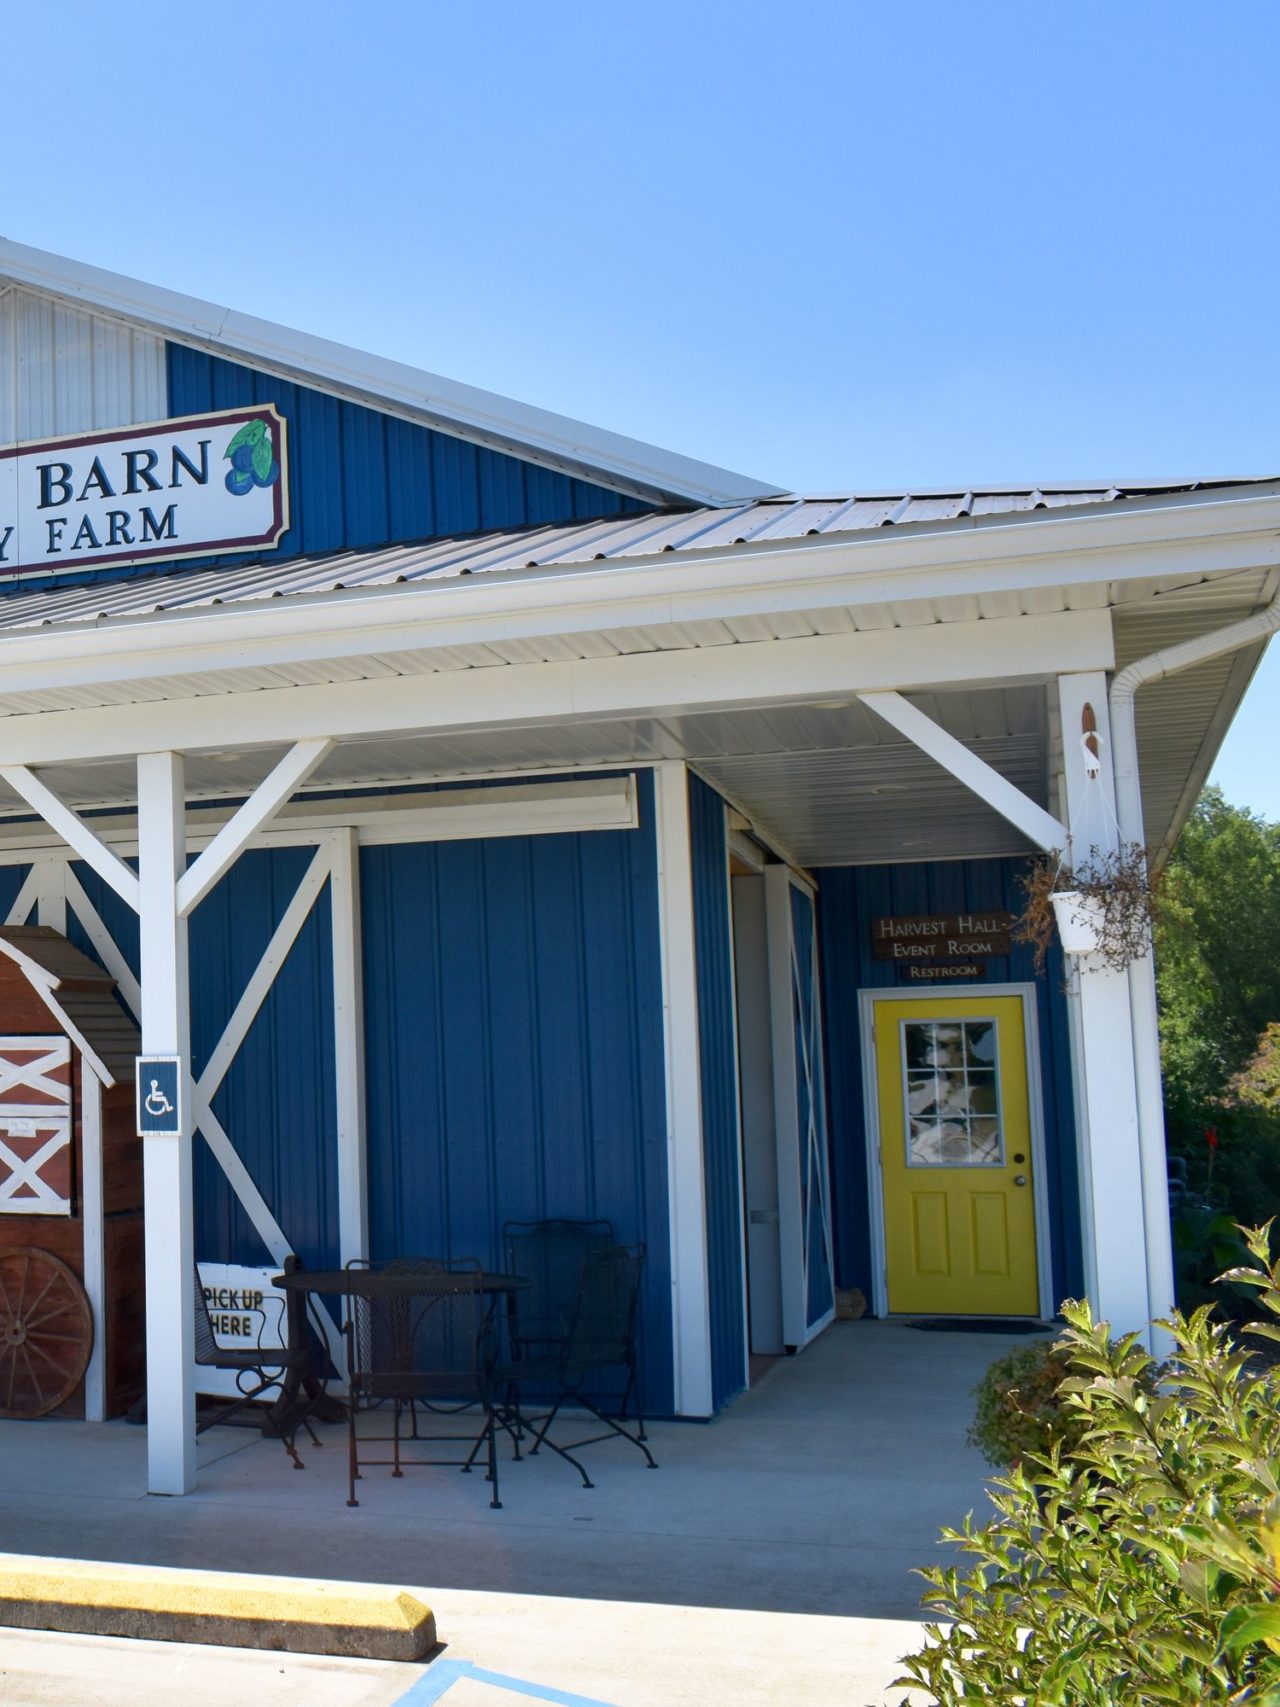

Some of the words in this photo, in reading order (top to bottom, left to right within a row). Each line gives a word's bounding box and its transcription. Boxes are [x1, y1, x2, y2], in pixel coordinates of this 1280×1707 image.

[36, 440, 212, 510] BARN
[46, 504, 179, 554] FARM
[880, 919, 947, 938] HARVEST
[958, 916, 1001, 934] HALL
[893, 943, 936, 957] EVENT
[948, 941, 992, 955] ROOM
[910, 966, 978, 978] RESTROOM
[203, 1287, 239, 1309] PICK
[242, 1289, 264, 1310] UP
[209, 1313, 251, 1337] HERE
